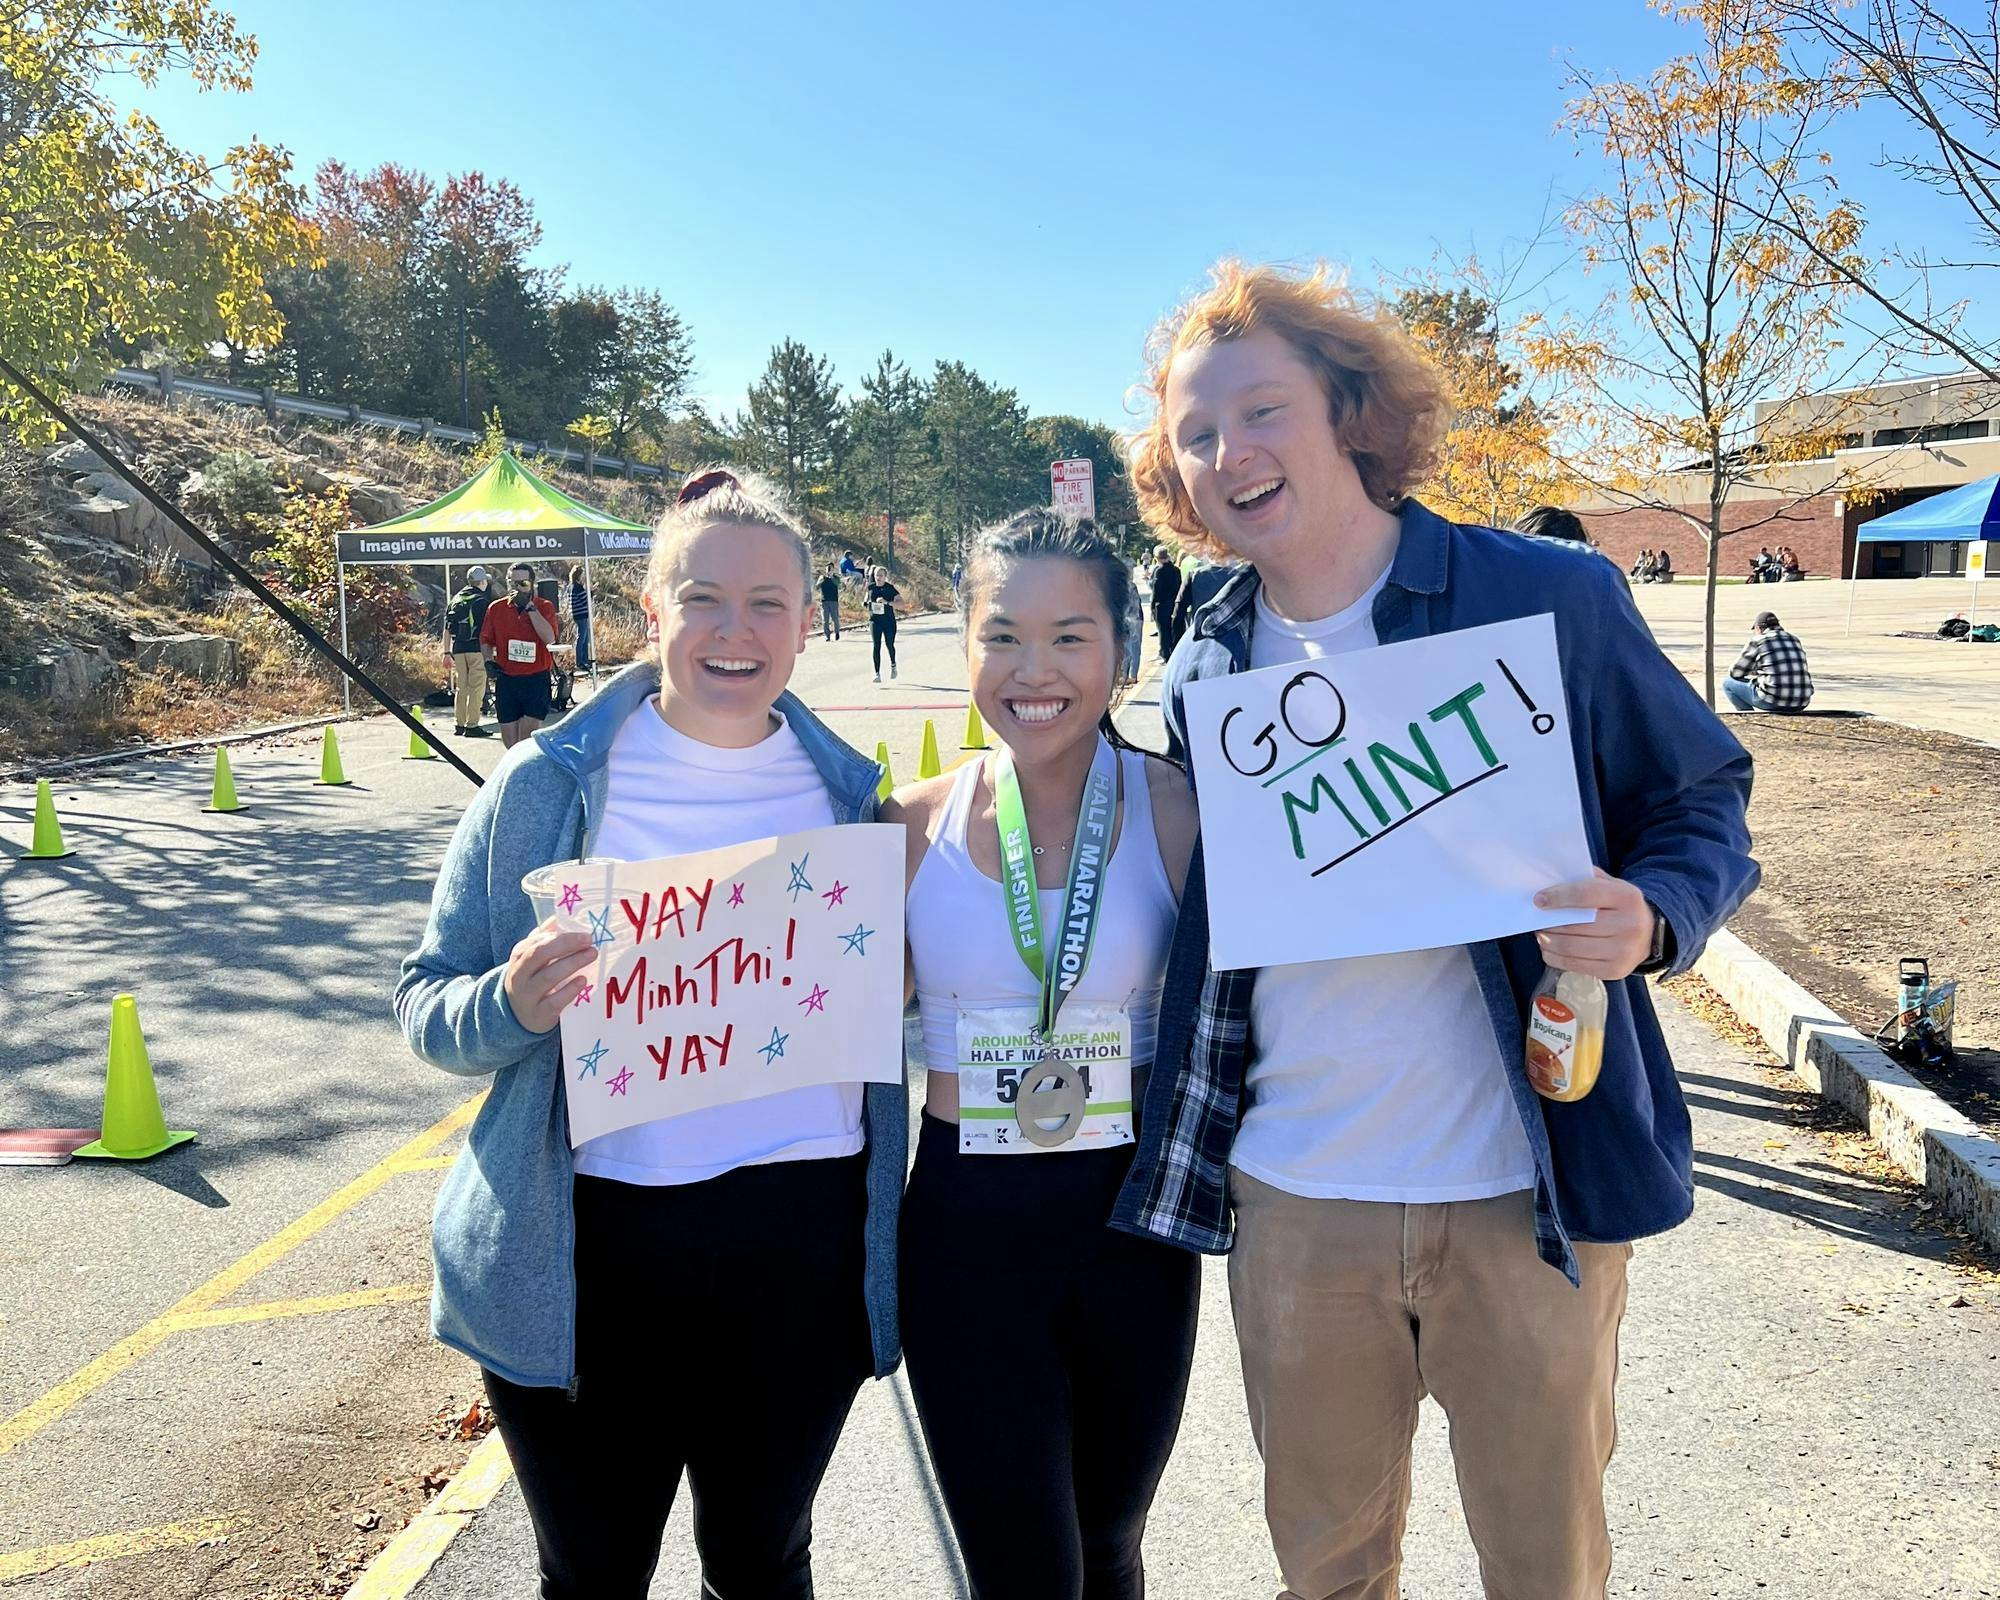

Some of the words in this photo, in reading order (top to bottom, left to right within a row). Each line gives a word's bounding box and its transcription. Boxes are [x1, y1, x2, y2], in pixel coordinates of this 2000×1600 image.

[1053, 466, 1064, 478] NO
[1065, 466, 1089, 476] PARKING
[1062, 482, 1082, 493] FIRE
[1062, 493, 1084, 505] LANE
[360, 539, 426, 554] Imagine
[429, 537, 473, 550] What
[476, 535, 531, 550] YuKan
[535, 535, 562, 549] Do.
[1220, 671, 1347, 777] GO
[1086, 771, 1111, 838] HALF
[1006, 827, 1038, 949] FINISHER
[620, 878, 714, 945] YAY
[1058, 843, 1100, 992] MARATHON
[971, 1035, 1034, 1048] AROUND
[1051, 1033, 1088, 1046] CAPE
[1091, 1031, 1121, 1044] ANN
[1533, 1018, 1572, 1042] Tropicana
[646, 1023, 734, 1082] YAY
[971, 1049, 1015, 1062] HALF
[1022, 1045, 1121, 1061] MARATHON
[996, 1065, 1093, 1104] 54
